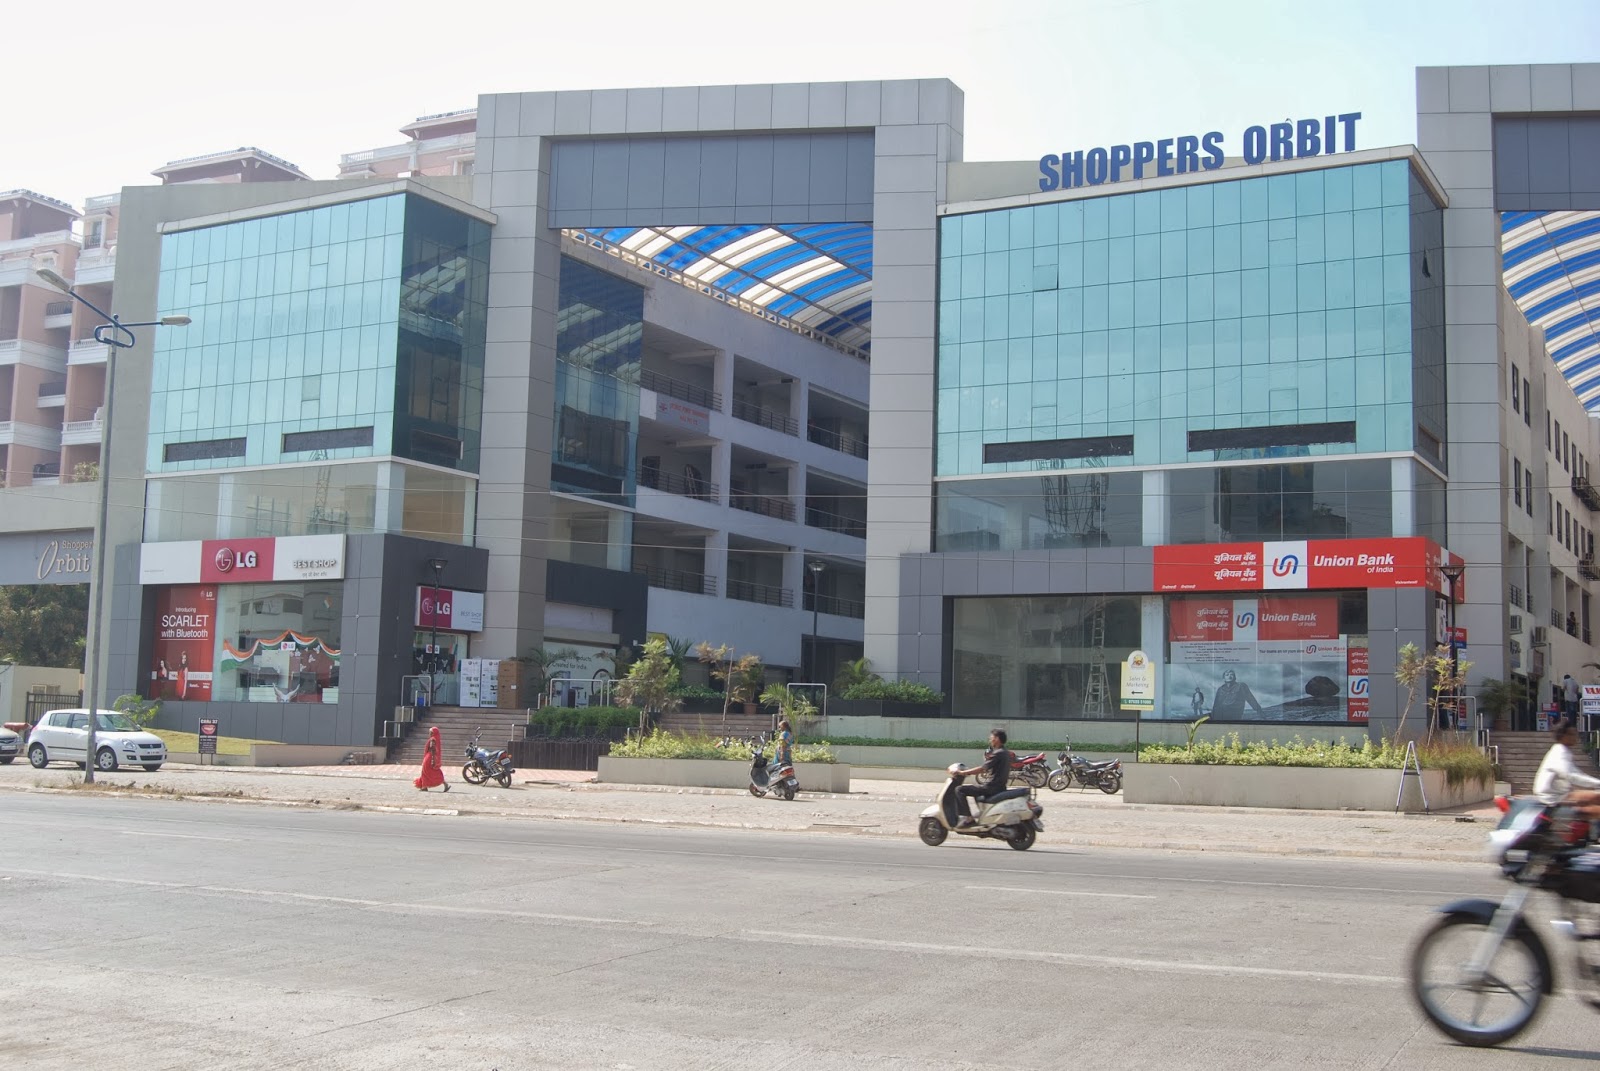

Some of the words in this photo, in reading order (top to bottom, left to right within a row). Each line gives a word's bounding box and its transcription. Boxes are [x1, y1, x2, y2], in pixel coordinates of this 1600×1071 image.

[1039, 131, 1224, 192] SHOPPERS
[1243, 112, 1361, 165] ORBIT
[62, 540, 94, 550] Shopper
[37, 540, 90, 580] Orbit
[236, 551, 257, 568] LG
[293, 560, 311, 569] BEST
[311, 559, 337, 568] SHOP
[1314, 555, 1354, 566] Union
[1357, 552, 1394, 565] Bank
[436, 602, 450, 615] LG
[161, 614, 209, 627] SCARLET
[1262, 613, 1289, 621] Union
[1291, 613, 1317, 621] Bank
[161, 628, 175, 638] with
[176, 628, 208, 638] Bluetooth
